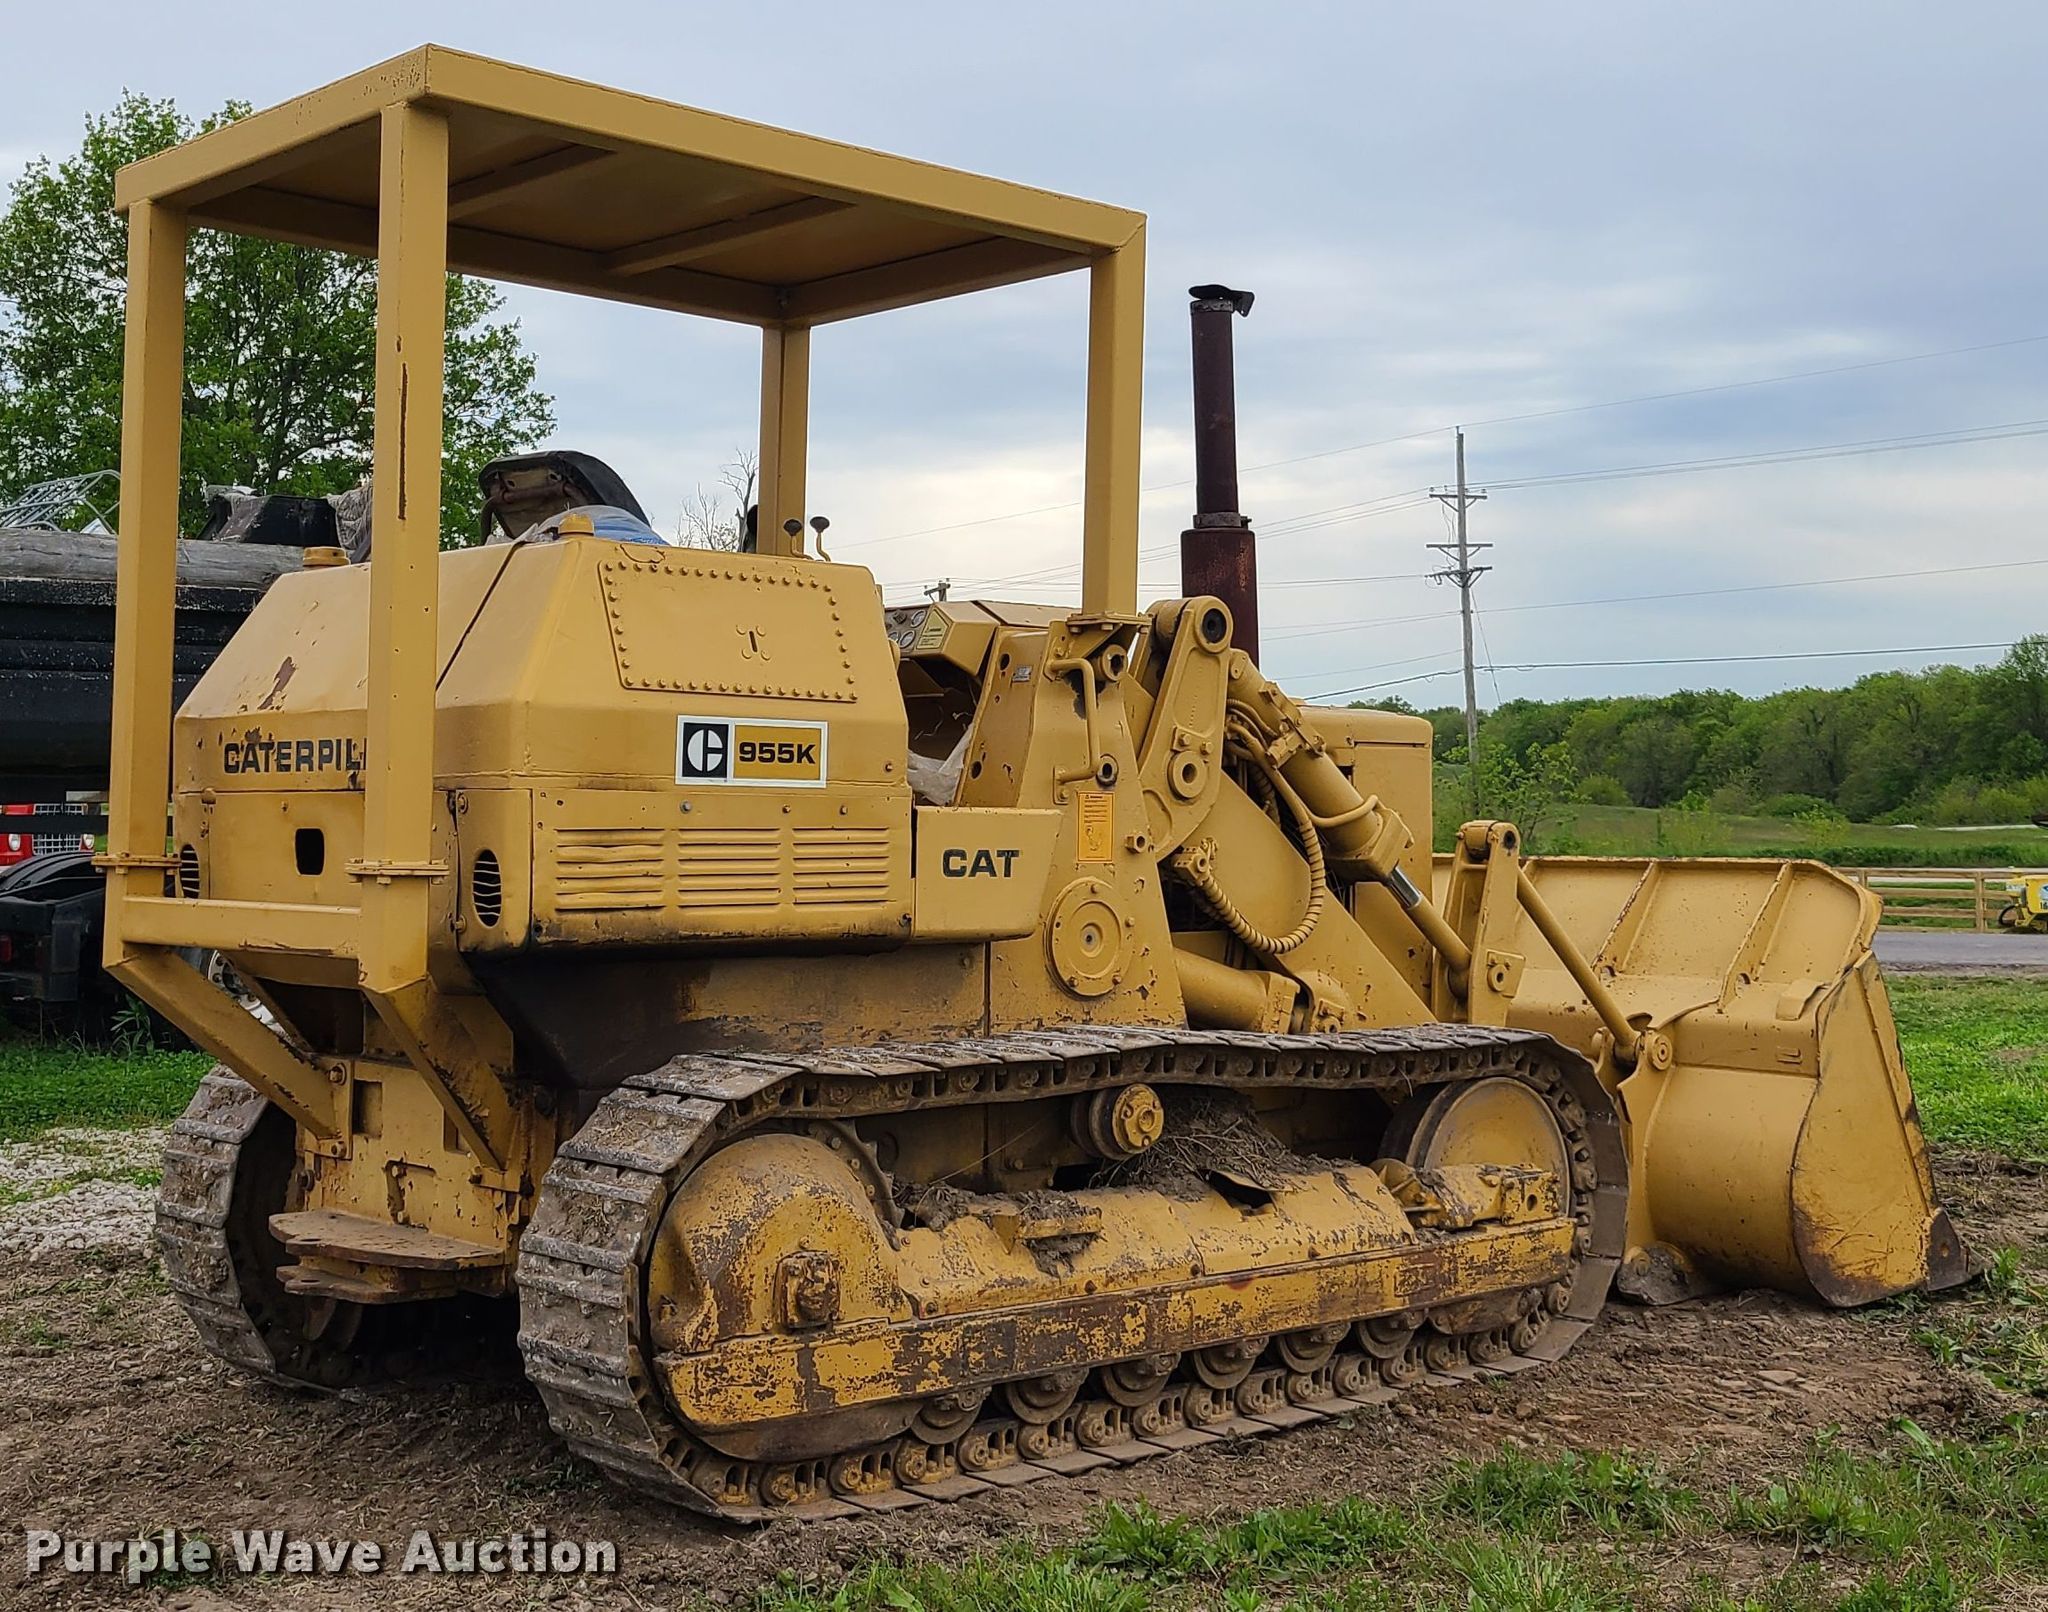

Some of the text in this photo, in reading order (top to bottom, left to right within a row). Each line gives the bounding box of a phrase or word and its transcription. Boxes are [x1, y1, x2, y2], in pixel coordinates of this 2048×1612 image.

[224, 738, 367, 773] CATERPIL
[739, 741, 816, 764] 955K
[942, 848, 1020, 878] CAT
